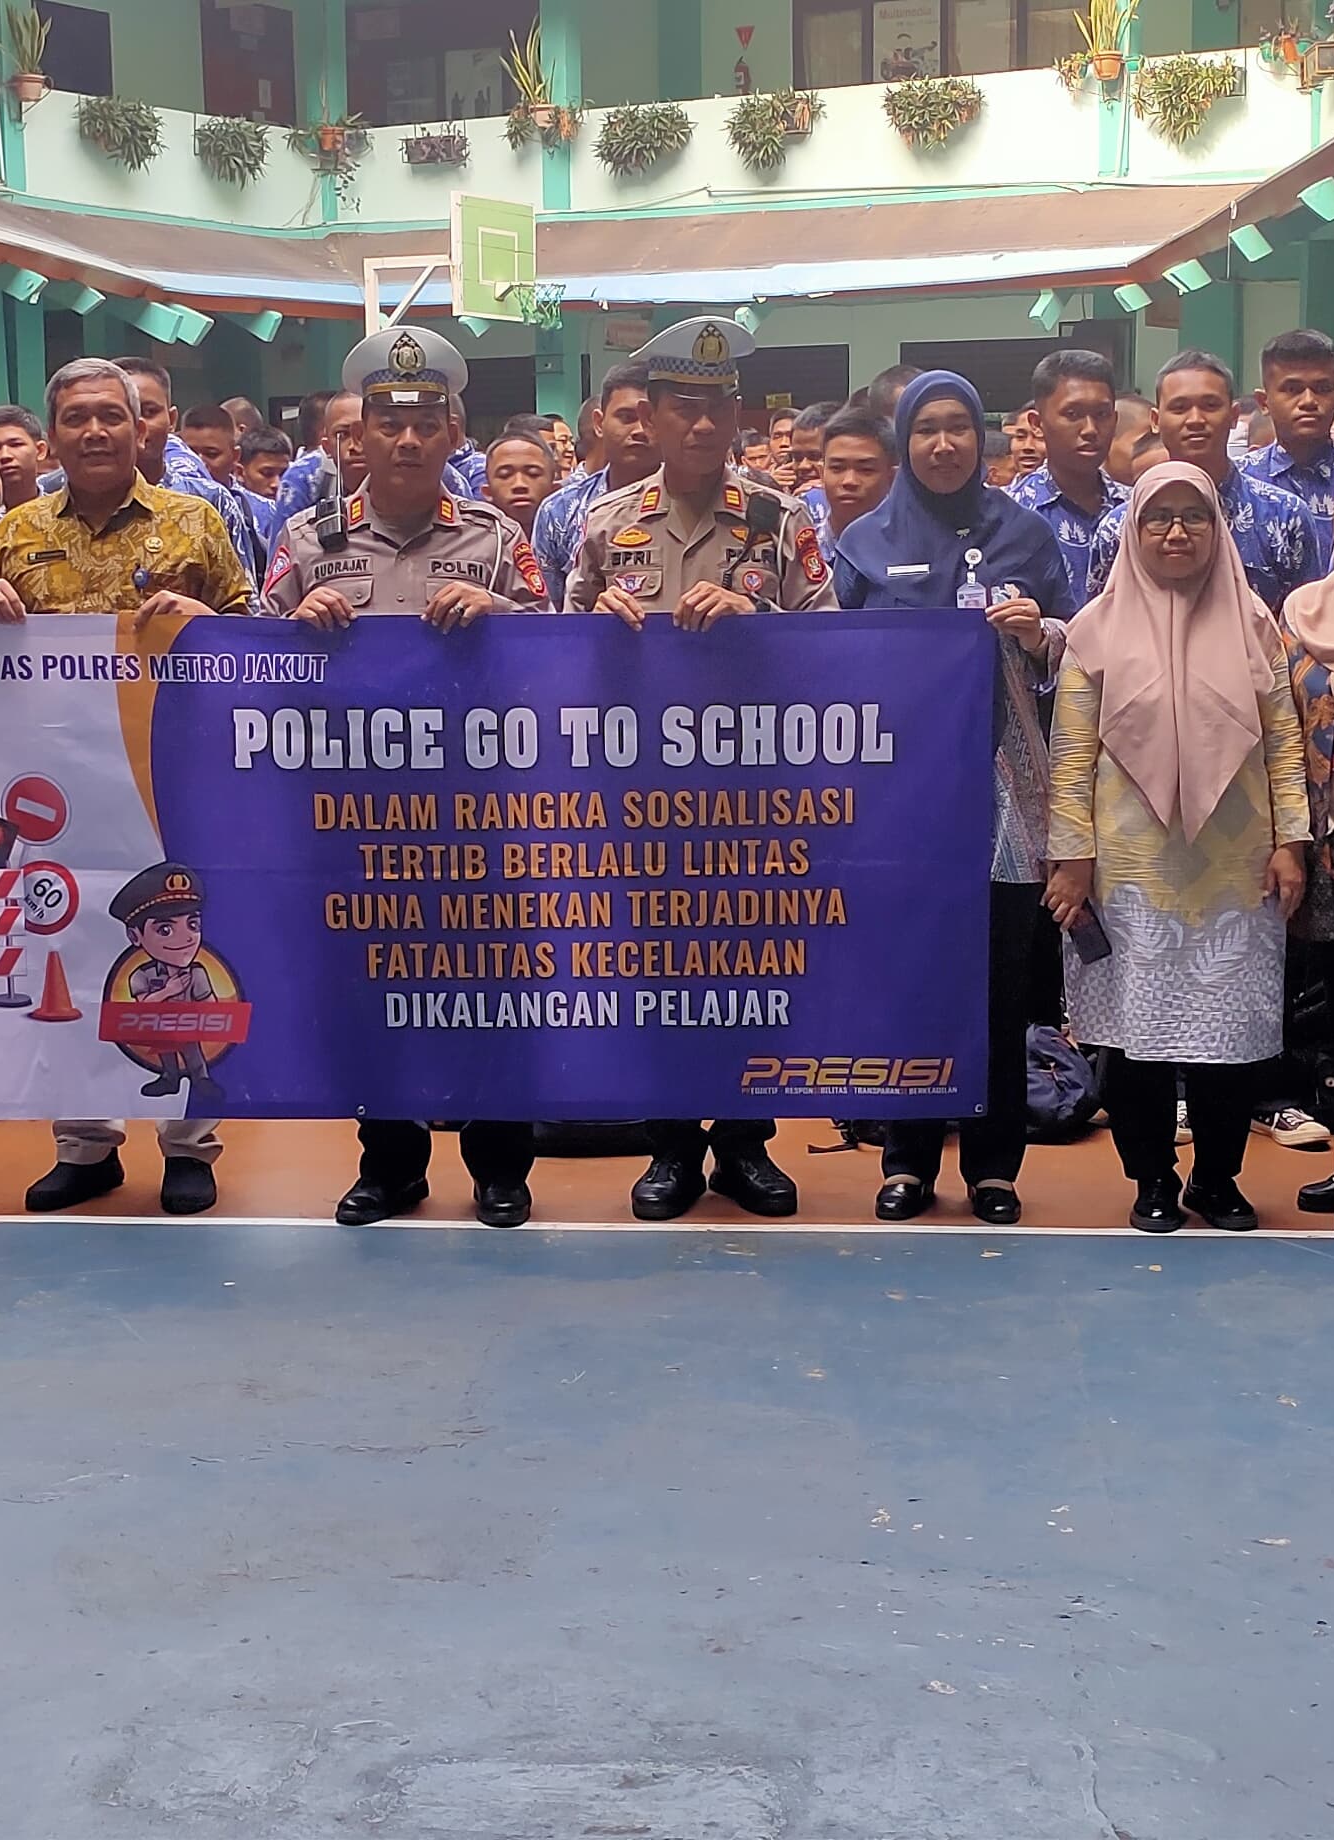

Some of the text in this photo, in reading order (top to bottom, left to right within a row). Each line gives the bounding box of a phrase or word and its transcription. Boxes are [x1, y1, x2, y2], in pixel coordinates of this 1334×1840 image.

[314, 558, 369, 579] SUDRAJAT
[430, 560, 483, 578] POLRI
[43, 654, 140, 682] POLRES
[149, 654, 237, 682] METRO
[243, 653, 328, 683] JAKUT
[232, 702, 895, 770] POLICE GO TO SCHOOL
[313, 788, 854, 830] DALAM RANGKA SOSIALISASI
[359, 839, 810, 880] TERTIB BERLALU LINTAS
[24, 893, 45, 920] km/h
[32, 877, 63, 909] 60
[325, 889, 847, 930] GUNA MENEKAN TERJADINYA
[367, 940, 807, 979] FATALITAS KECELAKAAN
[119, 1014, 233, 1032] PRESISI
[385, 989, 790, 1028] DIKALANGAN PELAJAR
[740, 1057, 955, 1087] PRESISI
